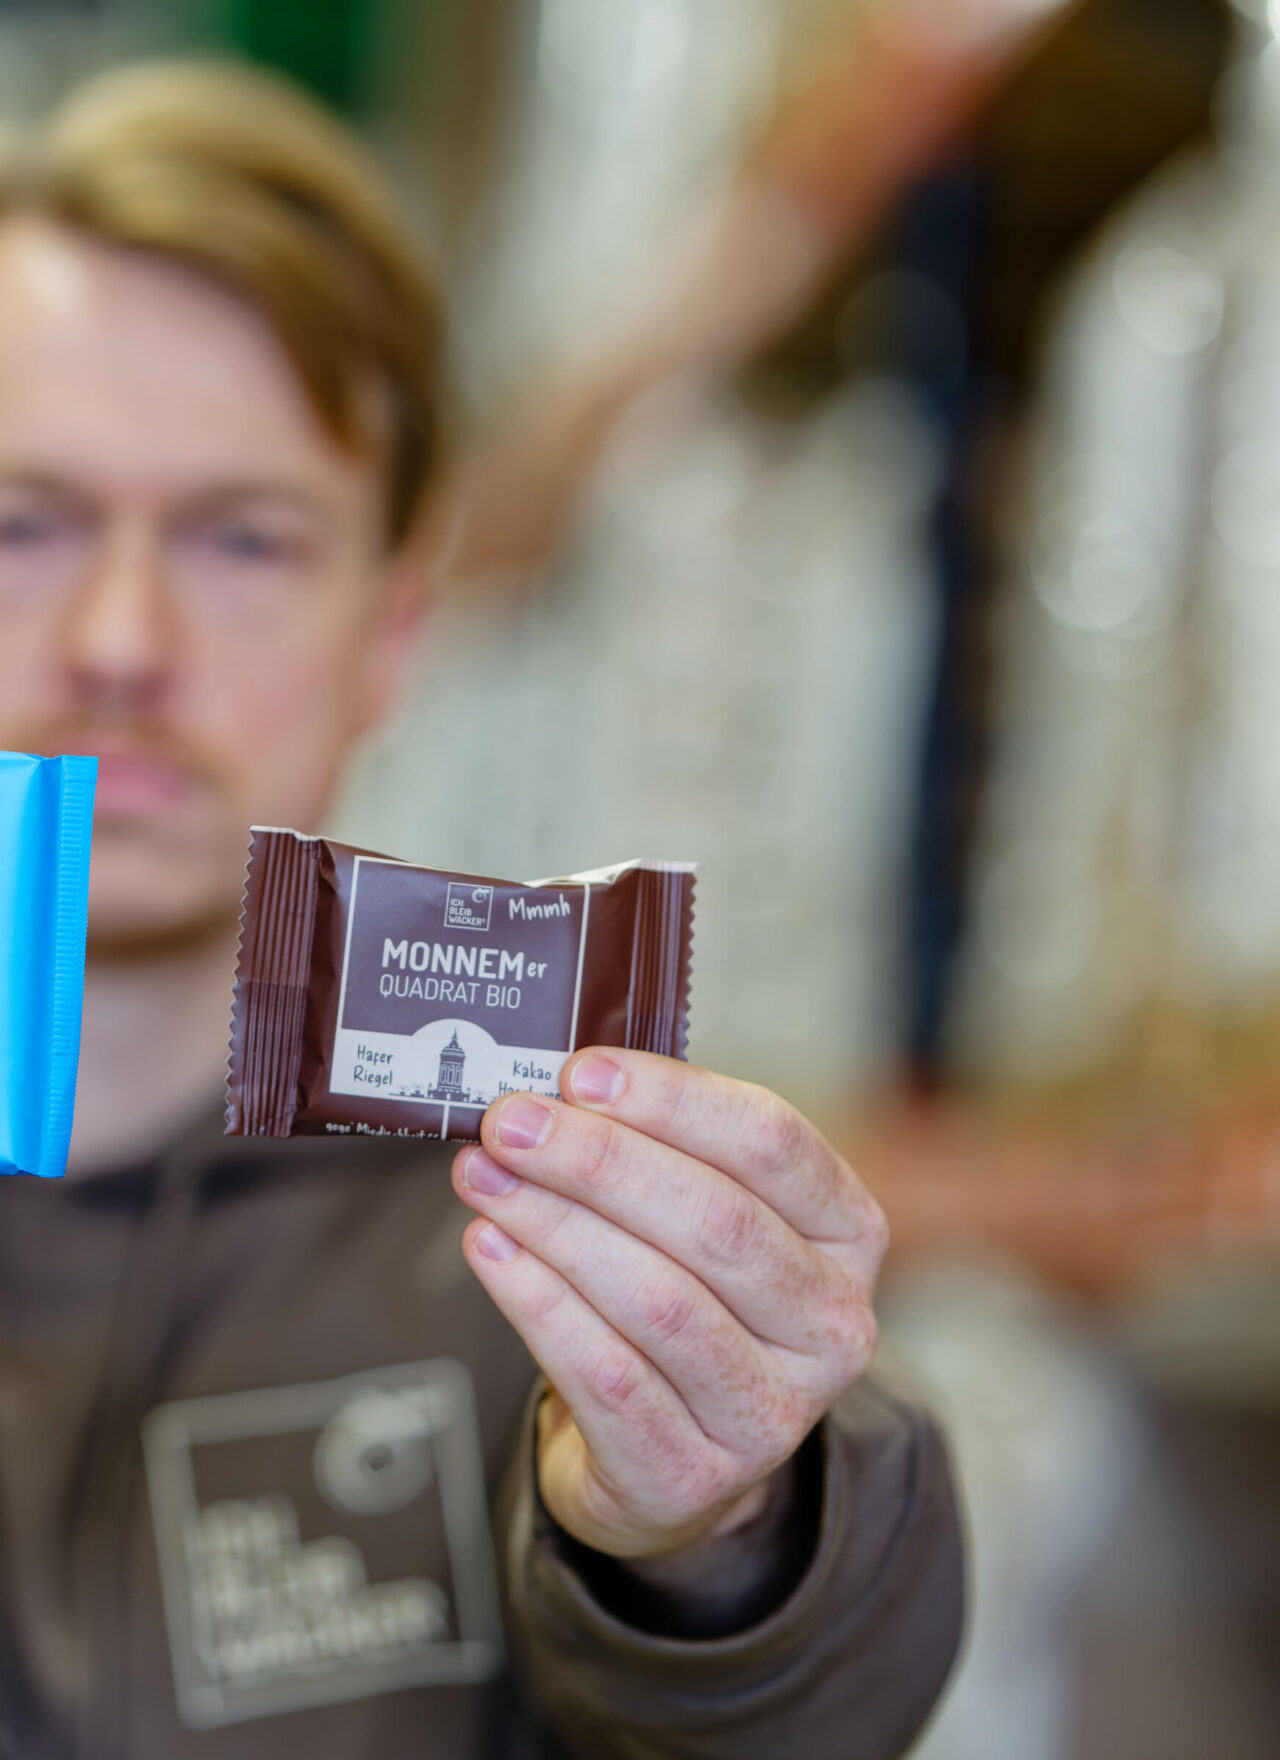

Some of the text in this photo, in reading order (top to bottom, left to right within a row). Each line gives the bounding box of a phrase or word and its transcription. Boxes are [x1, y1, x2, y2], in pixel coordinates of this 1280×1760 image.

[508, 892, 571, 920] Mmmh
[379, 973, 522, 1010] QUADRAT BIO
[357, 1044, 393, 1066] Hafer
[353, 1064, 393, 1088] Riegel
[512, 1060, 552, 1080] Kakao
